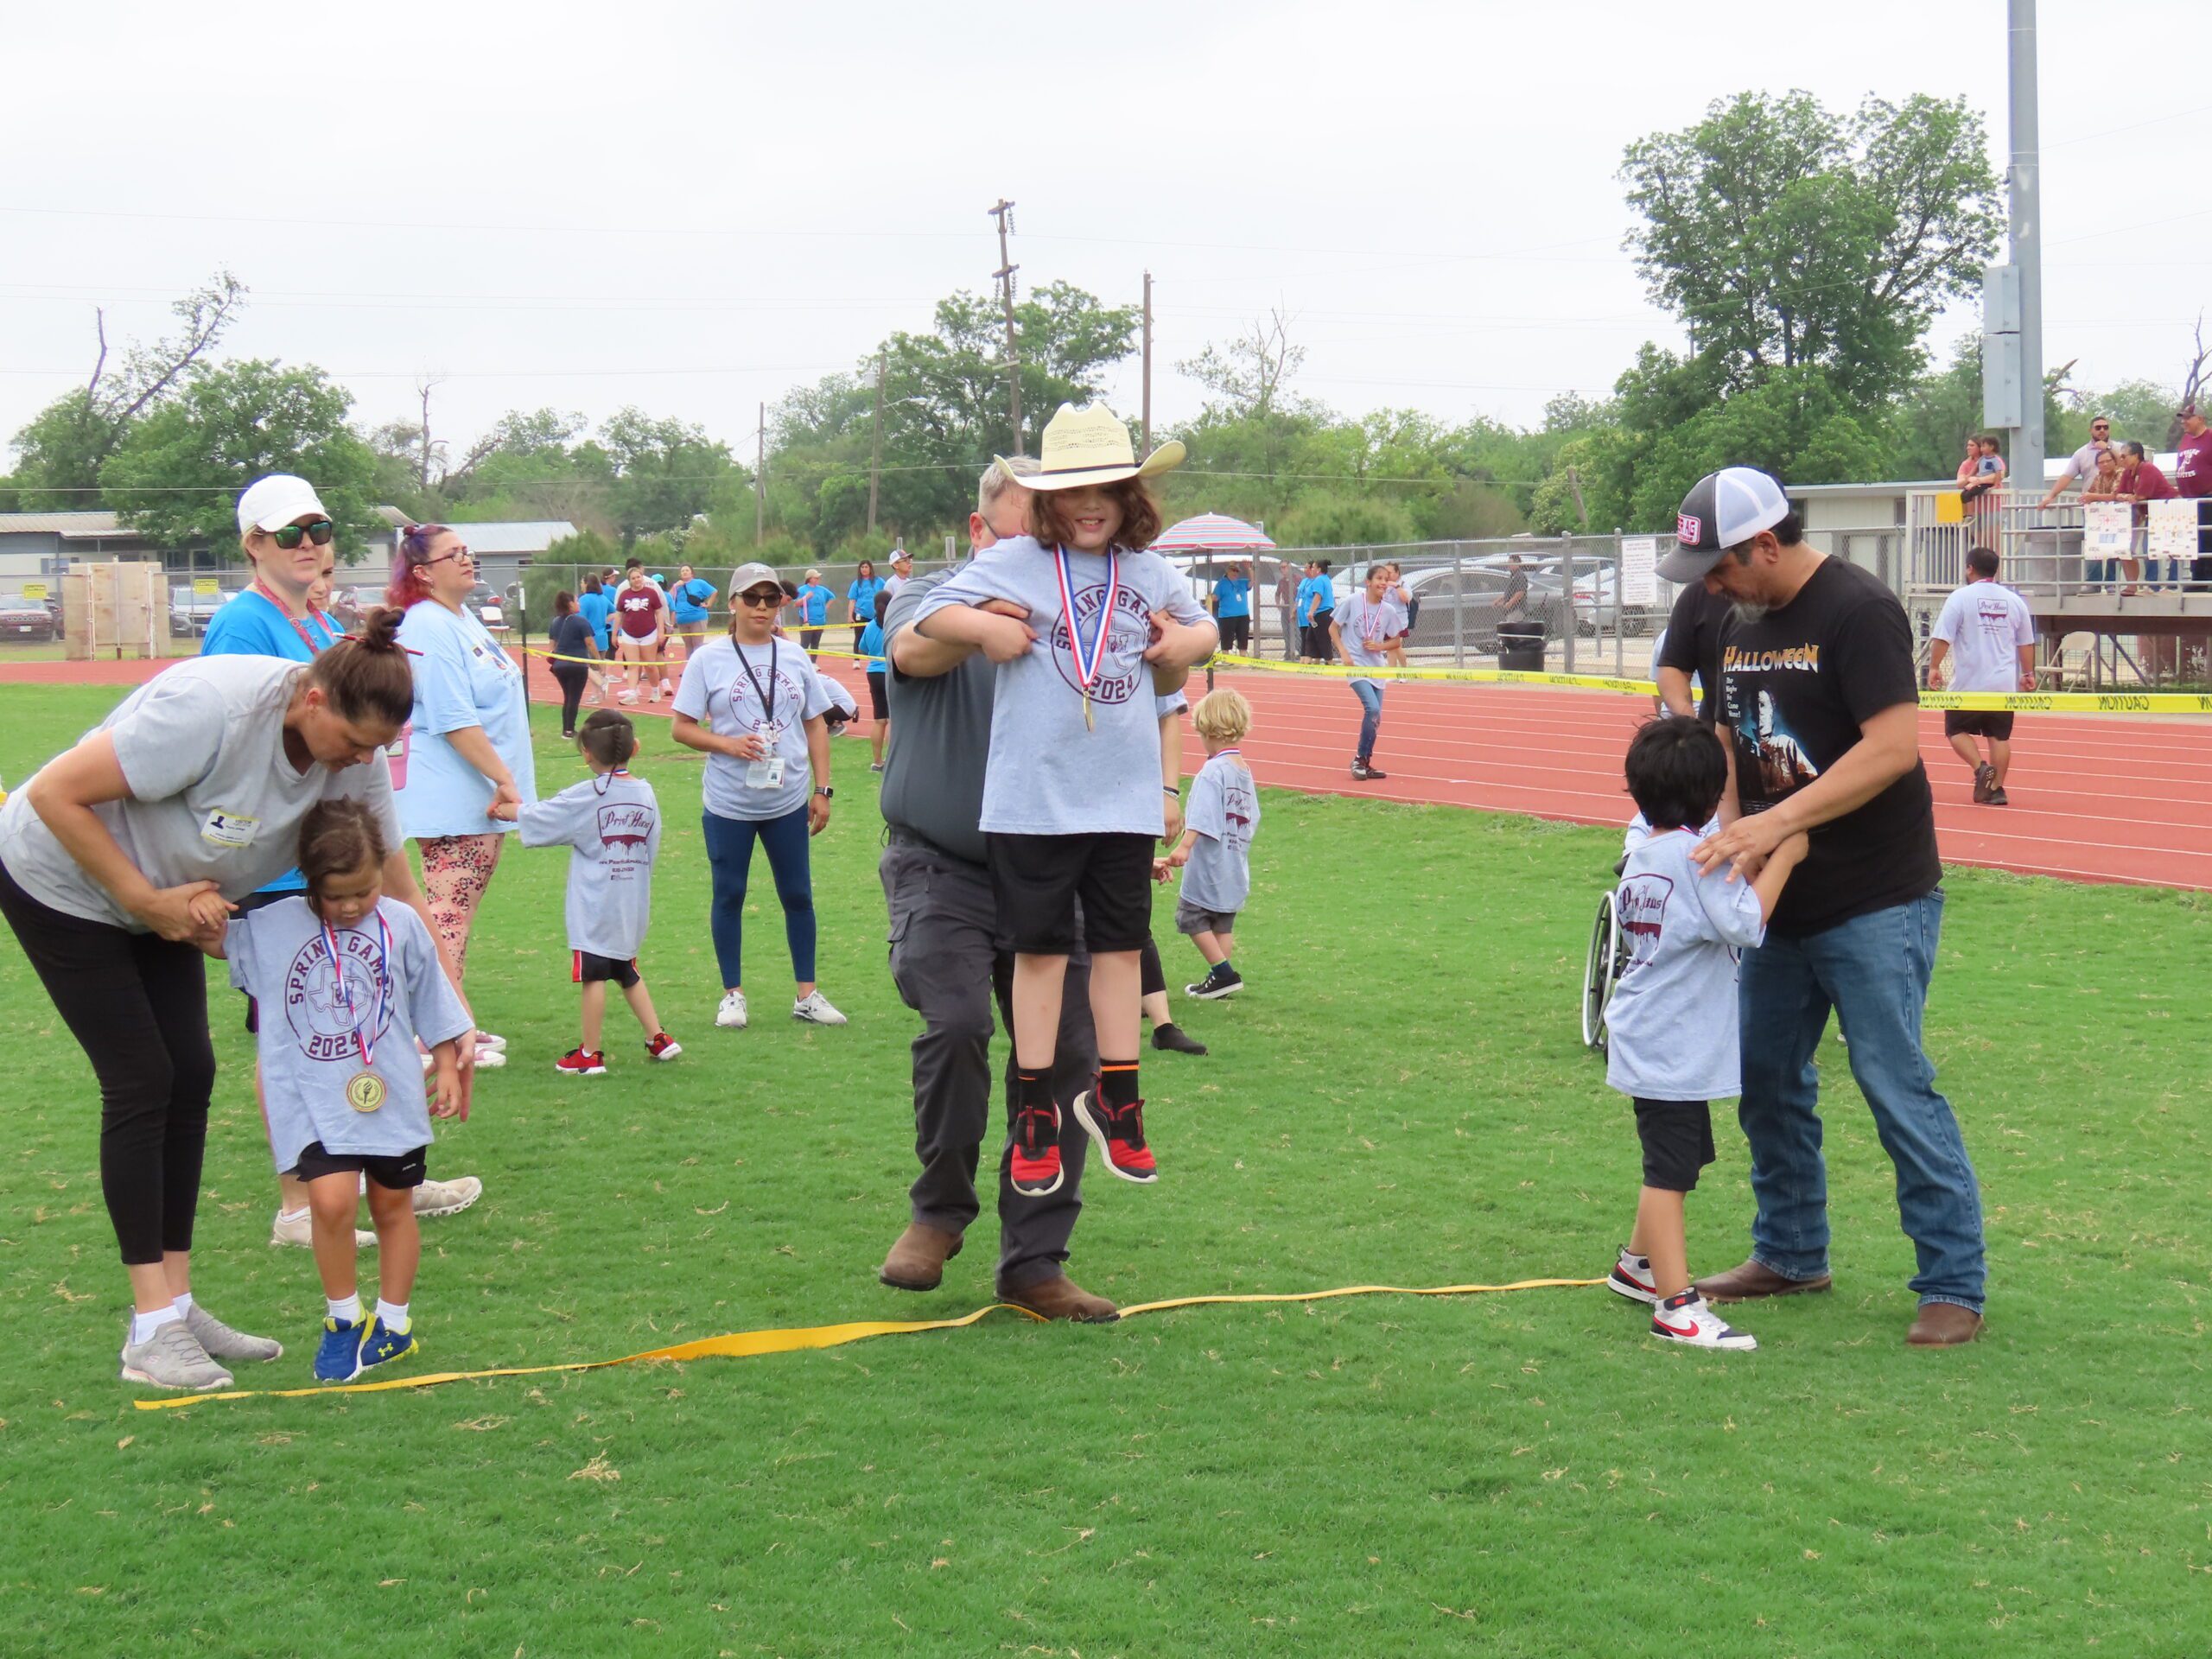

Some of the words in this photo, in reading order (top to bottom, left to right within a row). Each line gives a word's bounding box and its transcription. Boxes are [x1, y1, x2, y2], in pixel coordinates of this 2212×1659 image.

[1056, 588, 1106, 651] SPING
[1118, 590, 1152, 627] GAM
[733, 668, 762, 702] SPRIG
[1086, 674, 1133, 700] 2024
[752, 718, 784, 730] 24
[289, 936, 339, 1005] SPRIN
[308, 1031, 361, 1058] 2024
